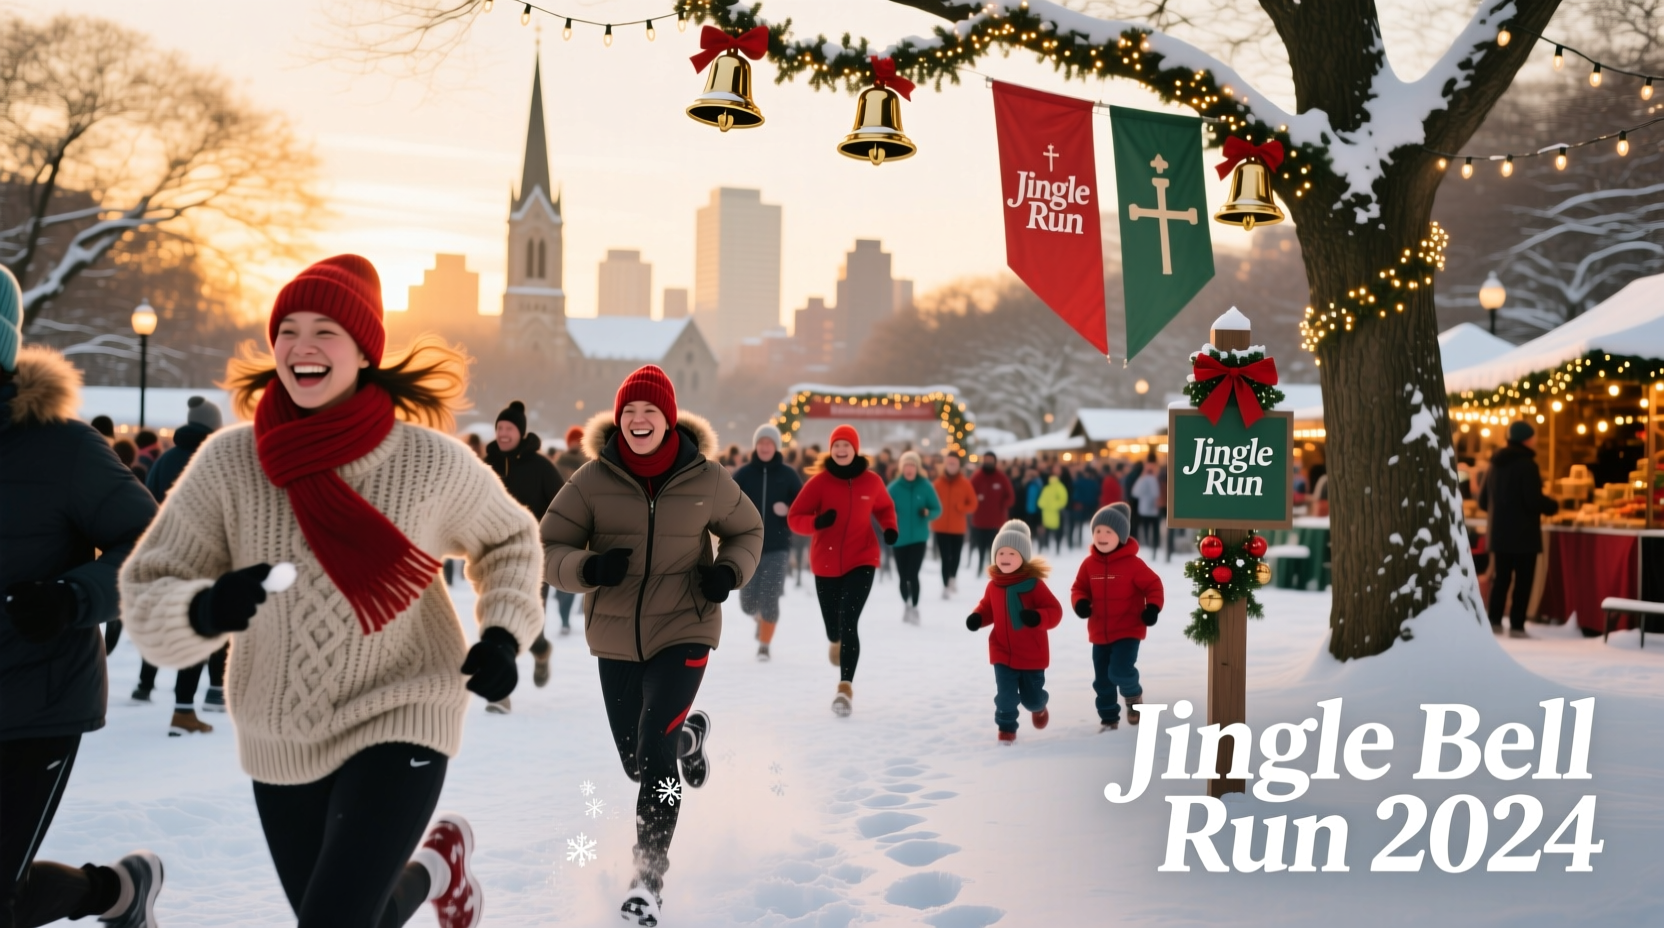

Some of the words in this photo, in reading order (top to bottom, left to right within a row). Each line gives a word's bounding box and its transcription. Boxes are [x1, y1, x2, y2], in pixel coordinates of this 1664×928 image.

[1007, 170, 1090, 210] Jingle
[1026, 201, 1083, 234] Run
[1182, 437, 1273, 475] Jingle
[1202, 467, 1263, 496] Run
